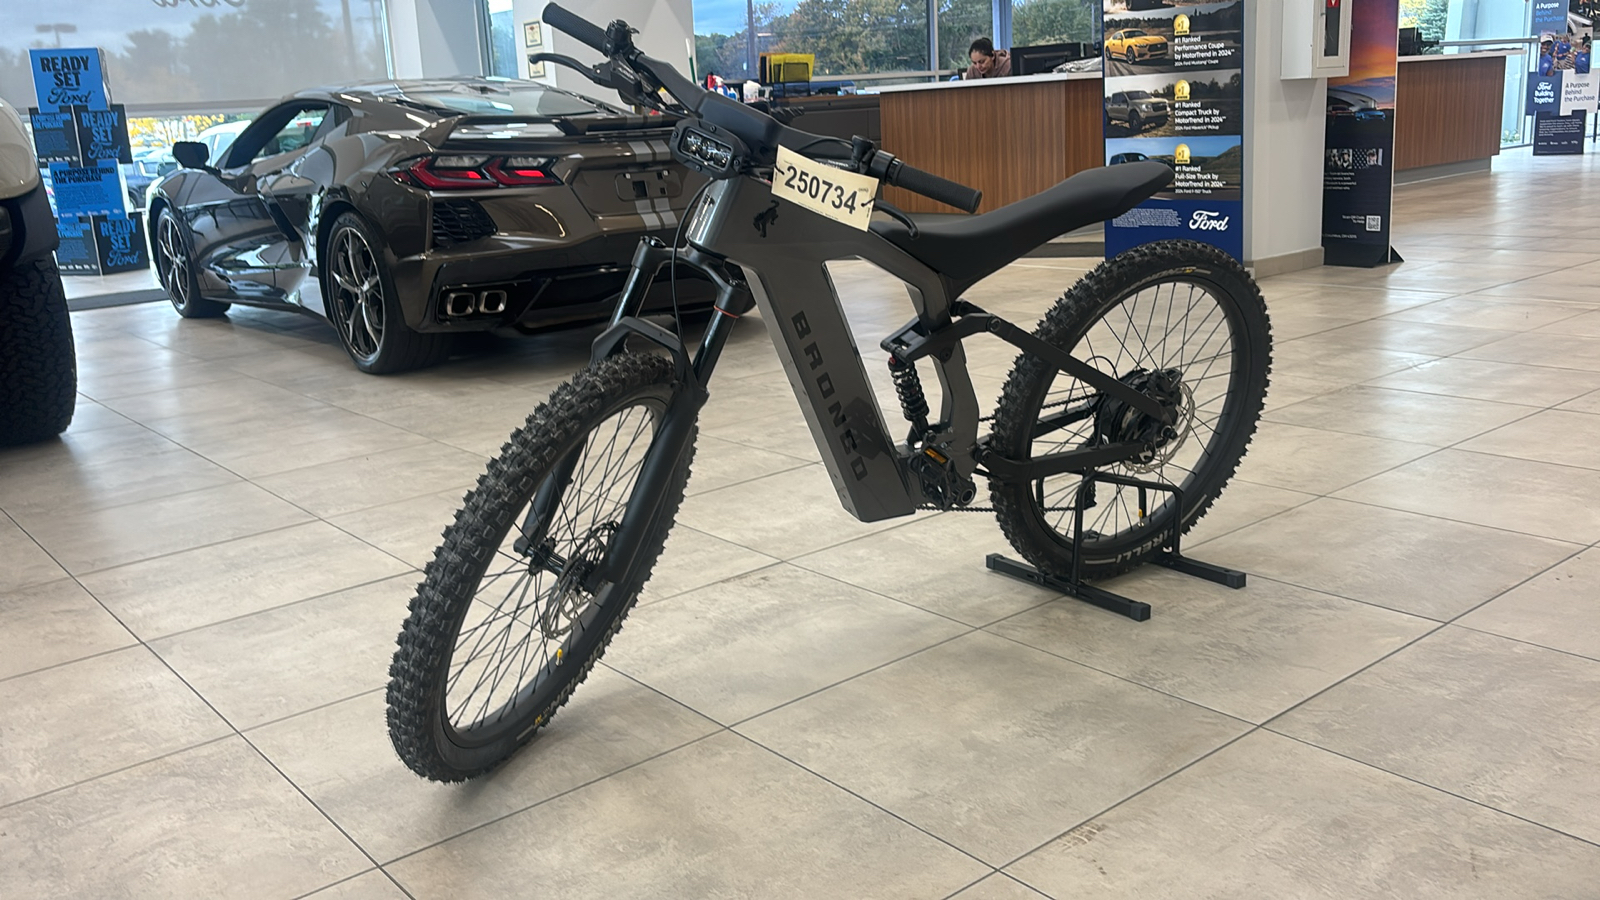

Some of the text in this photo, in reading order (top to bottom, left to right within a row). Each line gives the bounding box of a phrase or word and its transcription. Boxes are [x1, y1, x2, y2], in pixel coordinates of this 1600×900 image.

[1174, 42, 1225, 52] Performance Coupe
[1182, 51, 1211, 59] MotorTrend
[40, 55, 89, 73] READY
[53, 71, 81, 88] SET
[1537, 82, 1552, 90] Ford
[47, 87, 93, 105] Ford
[81, 111, 118, 128] READY
[1213, 108, 1220, 116] by
[92, 126, 113, 142] SET
[88, 141, 121, 159] Ford
[1212, 173, 1219, 181] by
[784, 165, 857, 215] 250734
[100, 218, 136, 237] READY
[1189, 210, 1229, 231] Ford
[110, 233, 131, 251] SET
[107, 249, 139, 267] Ford
[791, 311, 868, 481] BRONCO
